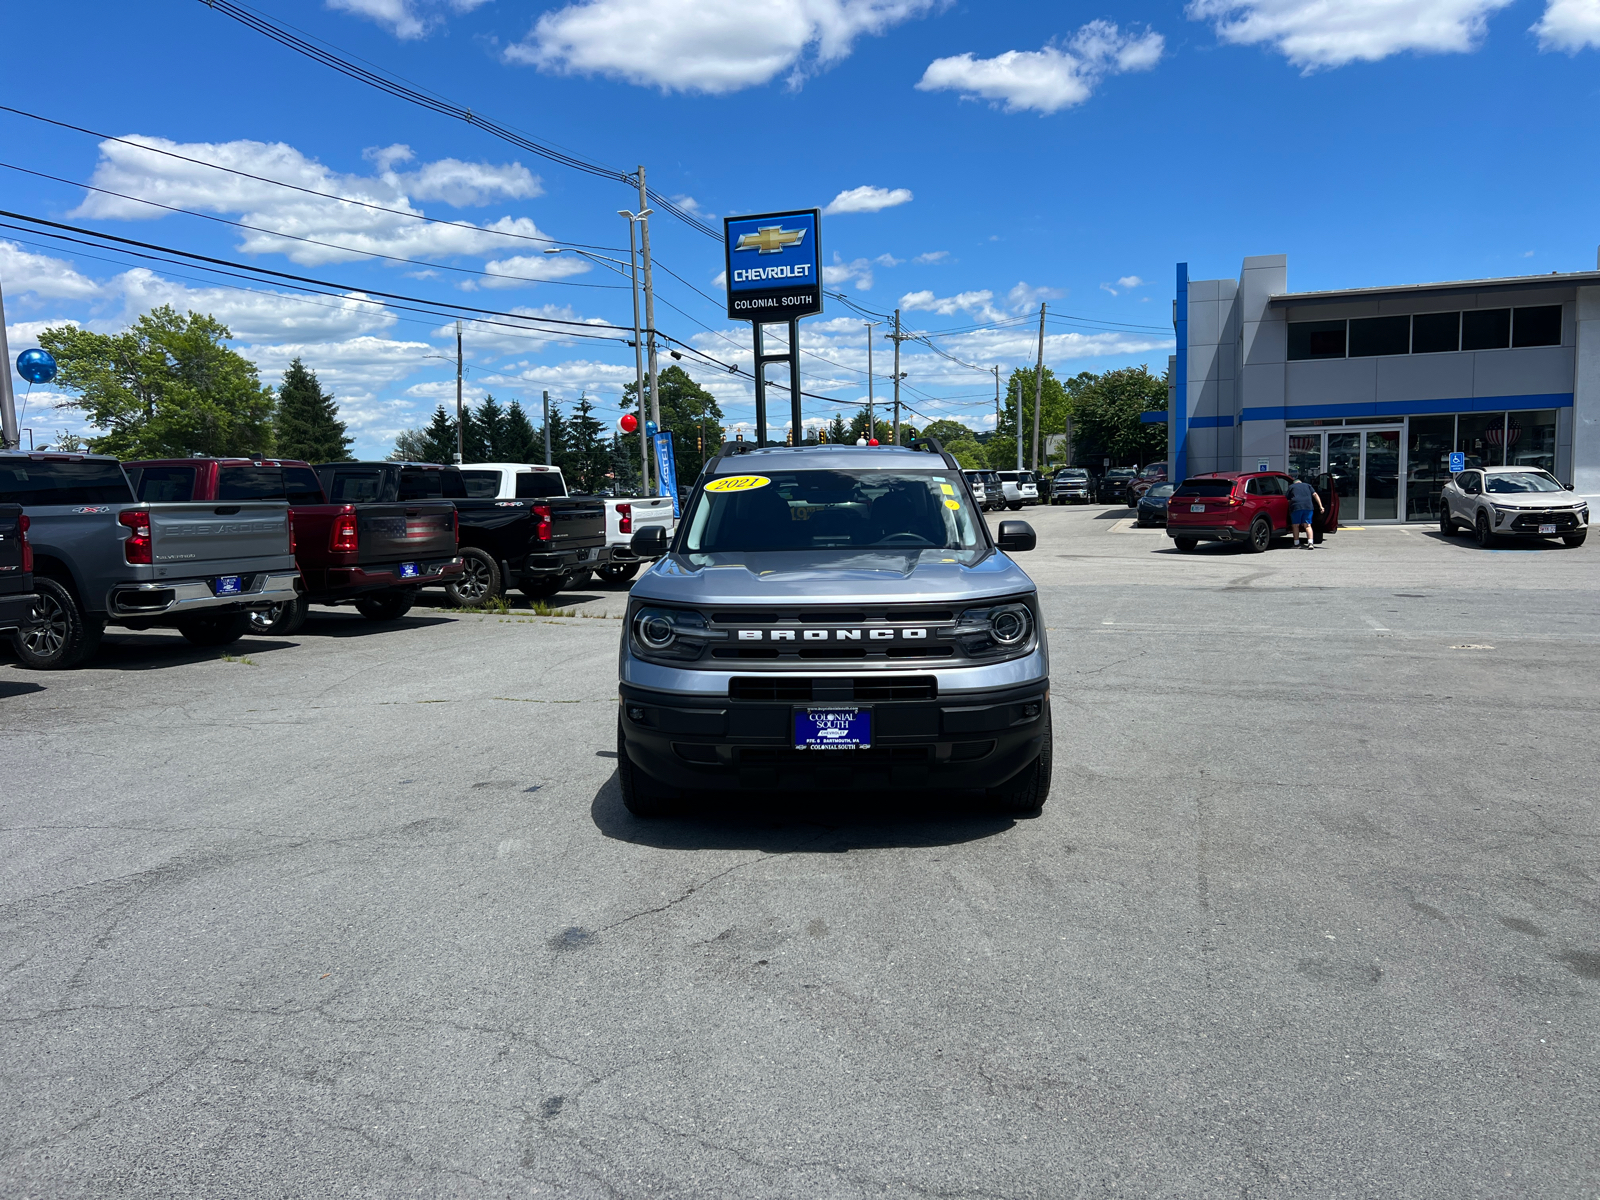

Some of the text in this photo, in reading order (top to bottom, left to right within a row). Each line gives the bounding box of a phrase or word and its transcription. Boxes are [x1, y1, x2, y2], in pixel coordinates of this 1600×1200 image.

[733, 263, 811, 282] CHEVROLET
[734, 295, 812, 310] COLONIAL SOUTH
[714, 478, 760, 490] 2021
[165, 522, 285, 536] CHEVROLET
[738, 628, 927, 641] BRONCO
[809, 713, 857, 721] COLONIAL
[816, 720, 849, 728] SOUTH
